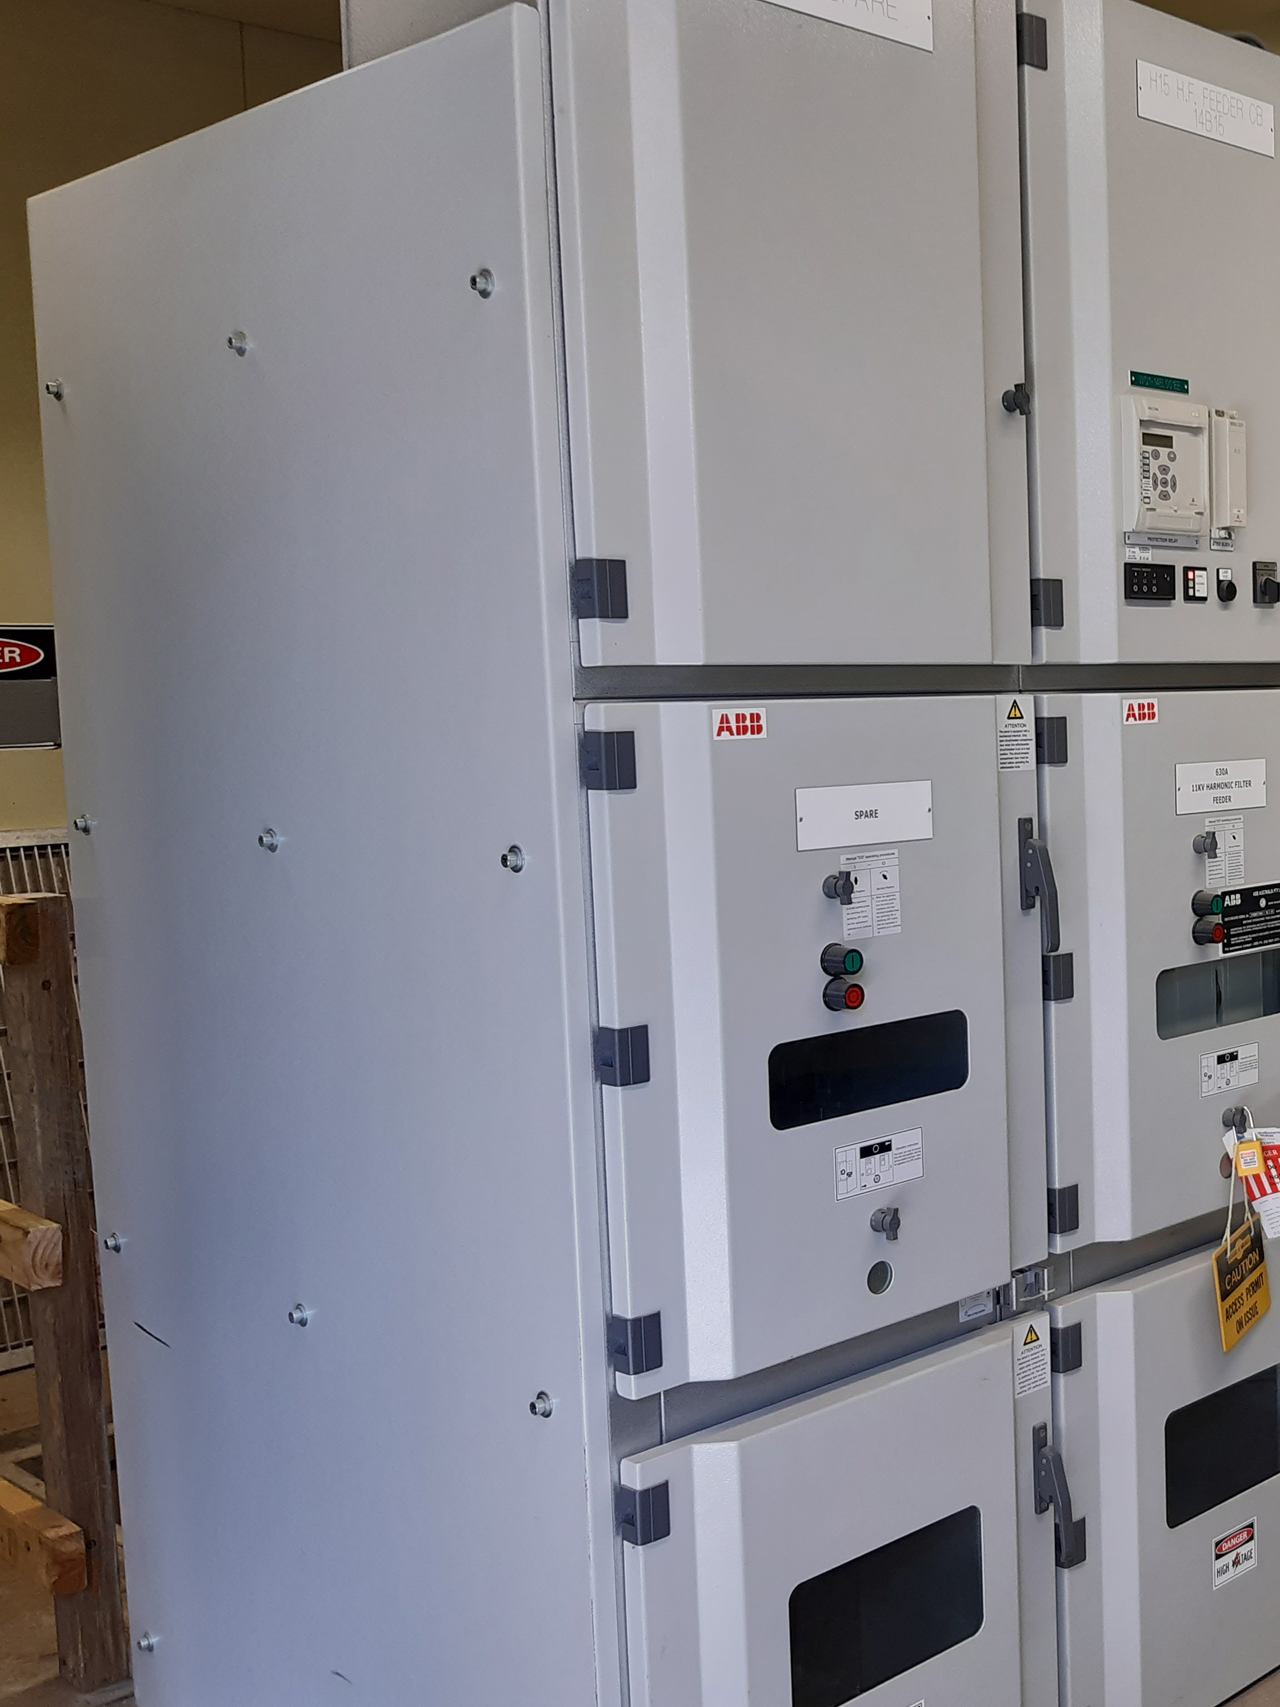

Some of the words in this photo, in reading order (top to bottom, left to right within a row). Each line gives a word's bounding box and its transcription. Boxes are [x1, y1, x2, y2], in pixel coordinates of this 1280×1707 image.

[1202, 87, 1244, 121] FEEDER
[1249, 102, 1263, 127] CB
[1194, 108, 1225, 137] 14B15
[1125, 702, 1157, 722] ABB
[716, 712, 763, 737] ABB
[1215, 768, 1229, 777] 630A
[1191, 784, 1206, 793] 11KV
[1206, 781, 1234, 791] HARMONIC
[1234, 779, 1252, 789] FILTER
[1212, 795, 1232, 805] FEEDER
[854, 808, 879, 820] SPARE
[1224, 893, 1242, 907] ABB
[1225, 1249, 1260, 1290] CAUTION
[1225, 1294, 1245, 1323] ACCESS
[1246, 1272, 1265, 1302] PERMIT
[1235, 1315, 1245, 1335] ON
[1245, 1301, 1259, 1326] ISSUE
[1021, 1344, 1043, 1355] ATTENTION
[1222, 1531, 1248, 1551] DANGER
[1216, 1562, 1229, 1578] HIGH
